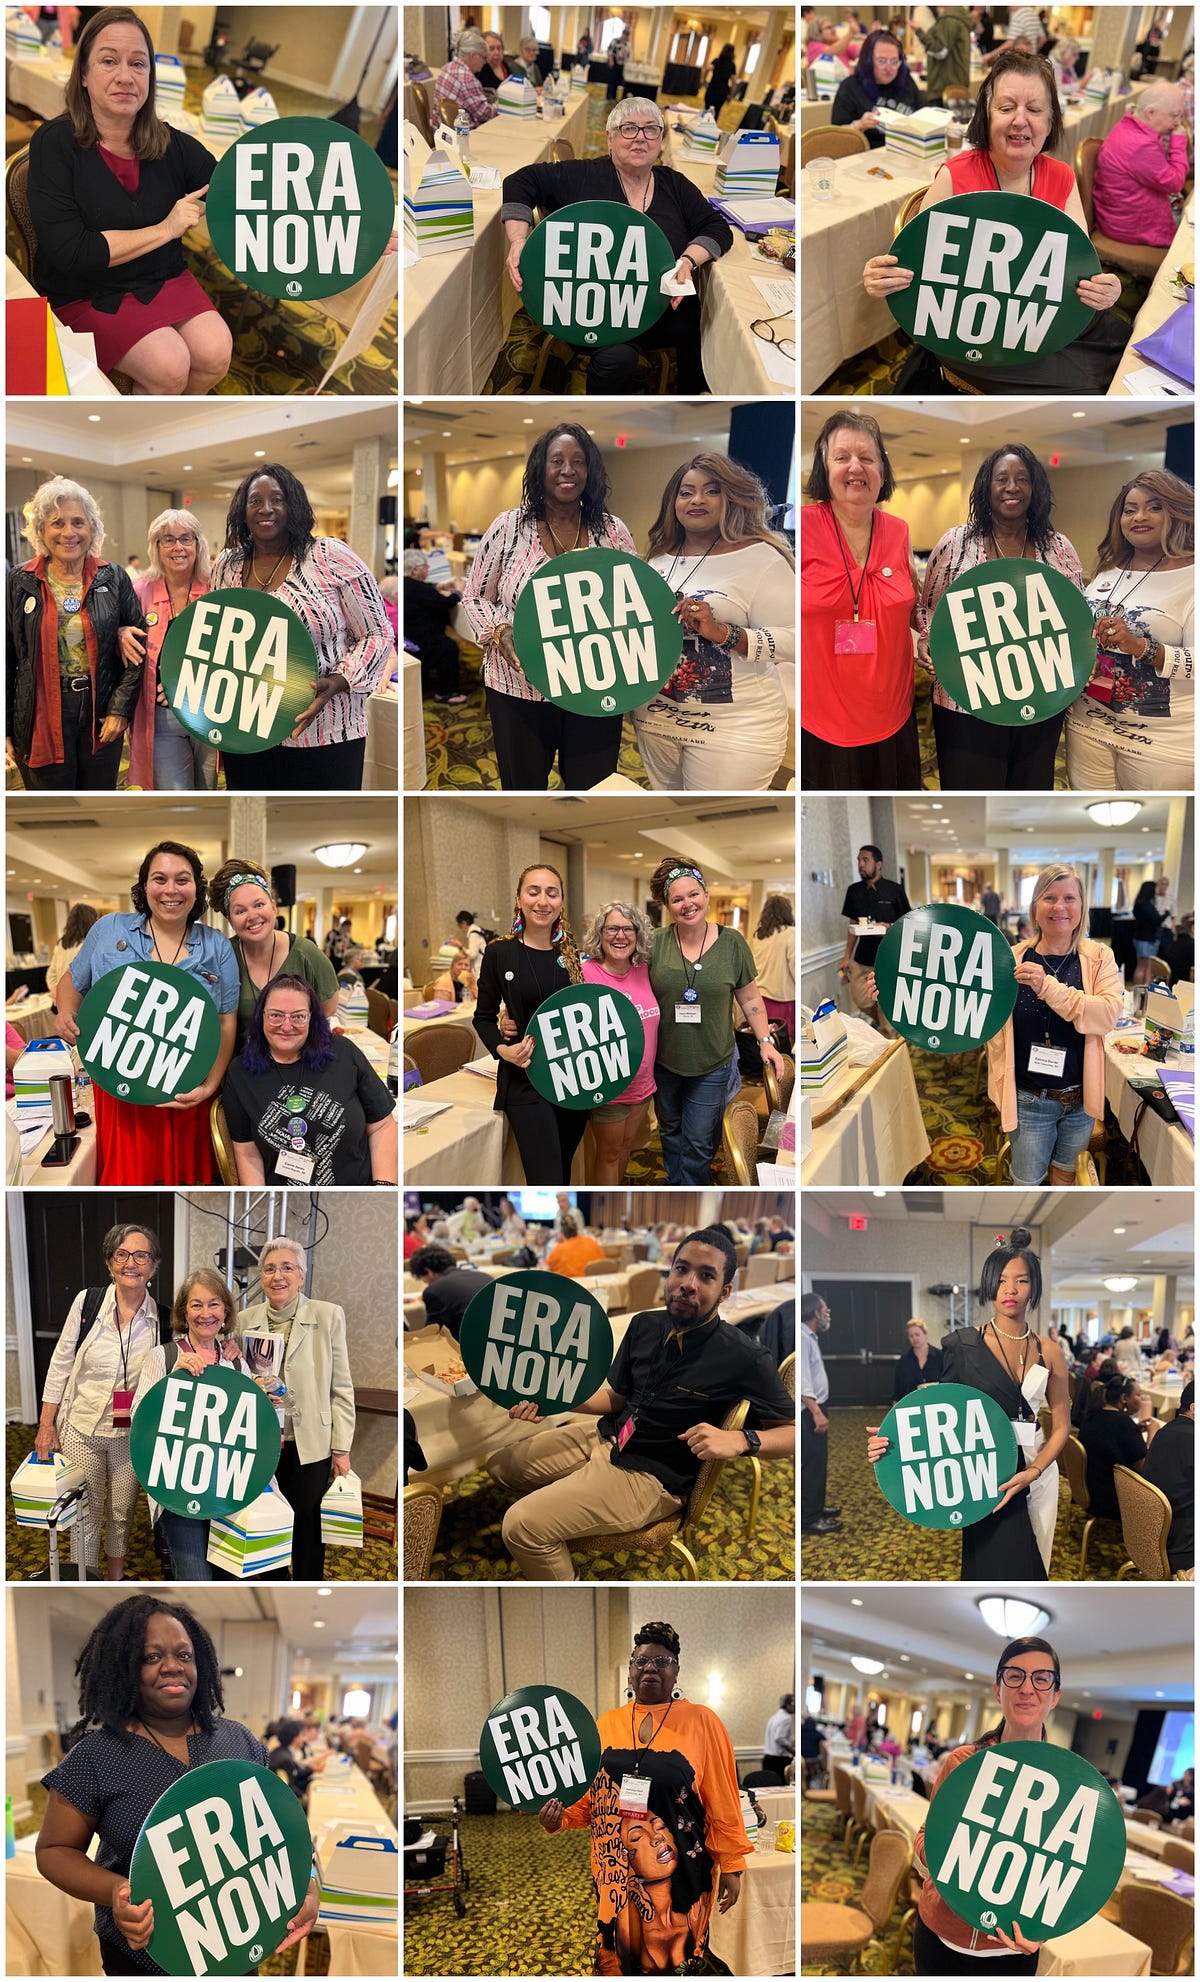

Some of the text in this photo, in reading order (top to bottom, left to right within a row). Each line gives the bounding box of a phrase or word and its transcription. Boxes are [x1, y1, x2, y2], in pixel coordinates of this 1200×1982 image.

[236, 142, 362, 211] ERA
[235, 214, 362, 275] NOW
[545, 222, 650, 282] ERA
[921, 212, 1069, 303] ERA
[543, 281, 649, 329] NOW
[914, 284, 1060, 352] NOW
[533, 562, 653, 639] ERA
[947, 573, 1068, 653] ERA
[185, 602, 289, 683] ERA
[542, 624, 659, 698] NOW
[959, 632, 1076, 710] NOW
[173, 657, 285, 740] NOW
[898, 911, 994, 991] ERA
[107, 968, 206, 1052] ERA
[537, 995, 627, 1061] ERA
[892, 975, 993, 1039] NOW
[85, 1015, 193, 1096] NOW
[548, 1037, 631, 1100] NOW
[488, 1285, 591, 1360] ERA
[481, 1341, 587, 1404] NOW
[158, 1379, 258, 1451] ERA
[895, 1398, 997, 1463] ERA
[147, 1435, 256, 1502] NOW
[901, 1451, 999, 1514] NOW
[488, 1695, 578, 1764] ERA
[501, 1740, 587, 1804] NOW
[145, 1775, 285, 1910] ERA
[622, 1811, 645, 1819] SPEAKER
[961, 1754, 1108, 1866] ERA
[175, 1845, 298, 1975] NOW
[937, 1821, 1084, 1928] NOW
